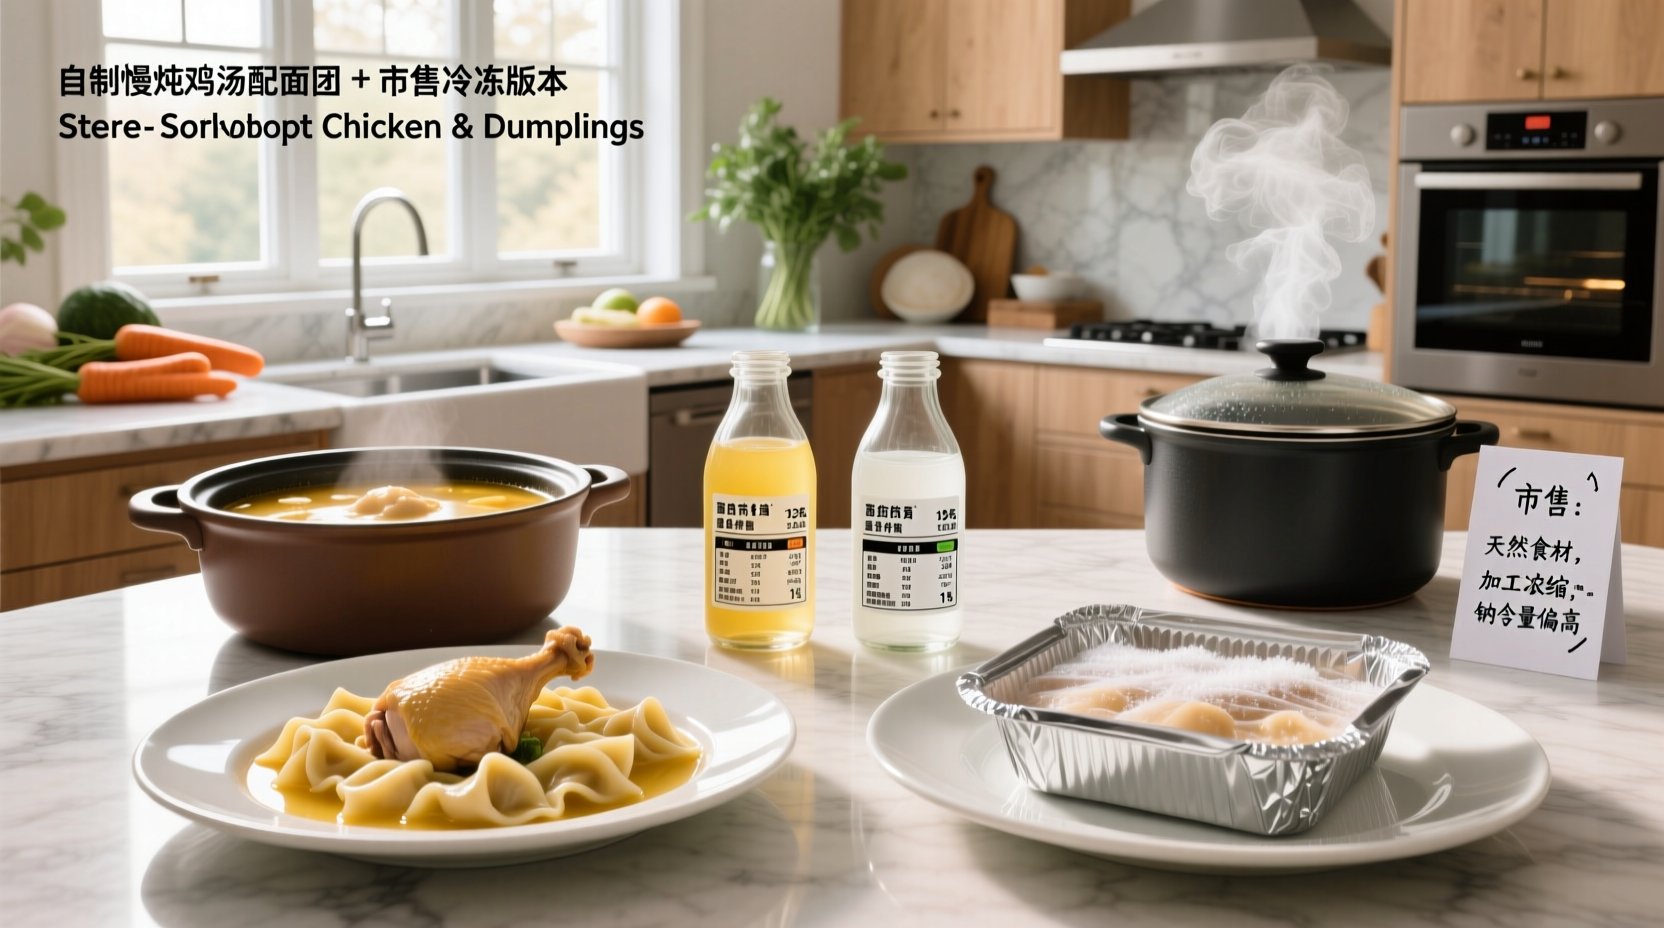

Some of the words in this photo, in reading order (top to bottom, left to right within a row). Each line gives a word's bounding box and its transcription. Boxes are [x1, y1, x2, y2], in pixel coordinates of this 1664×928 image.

[1473, 601, 1581, 636] 钠含量偏高
